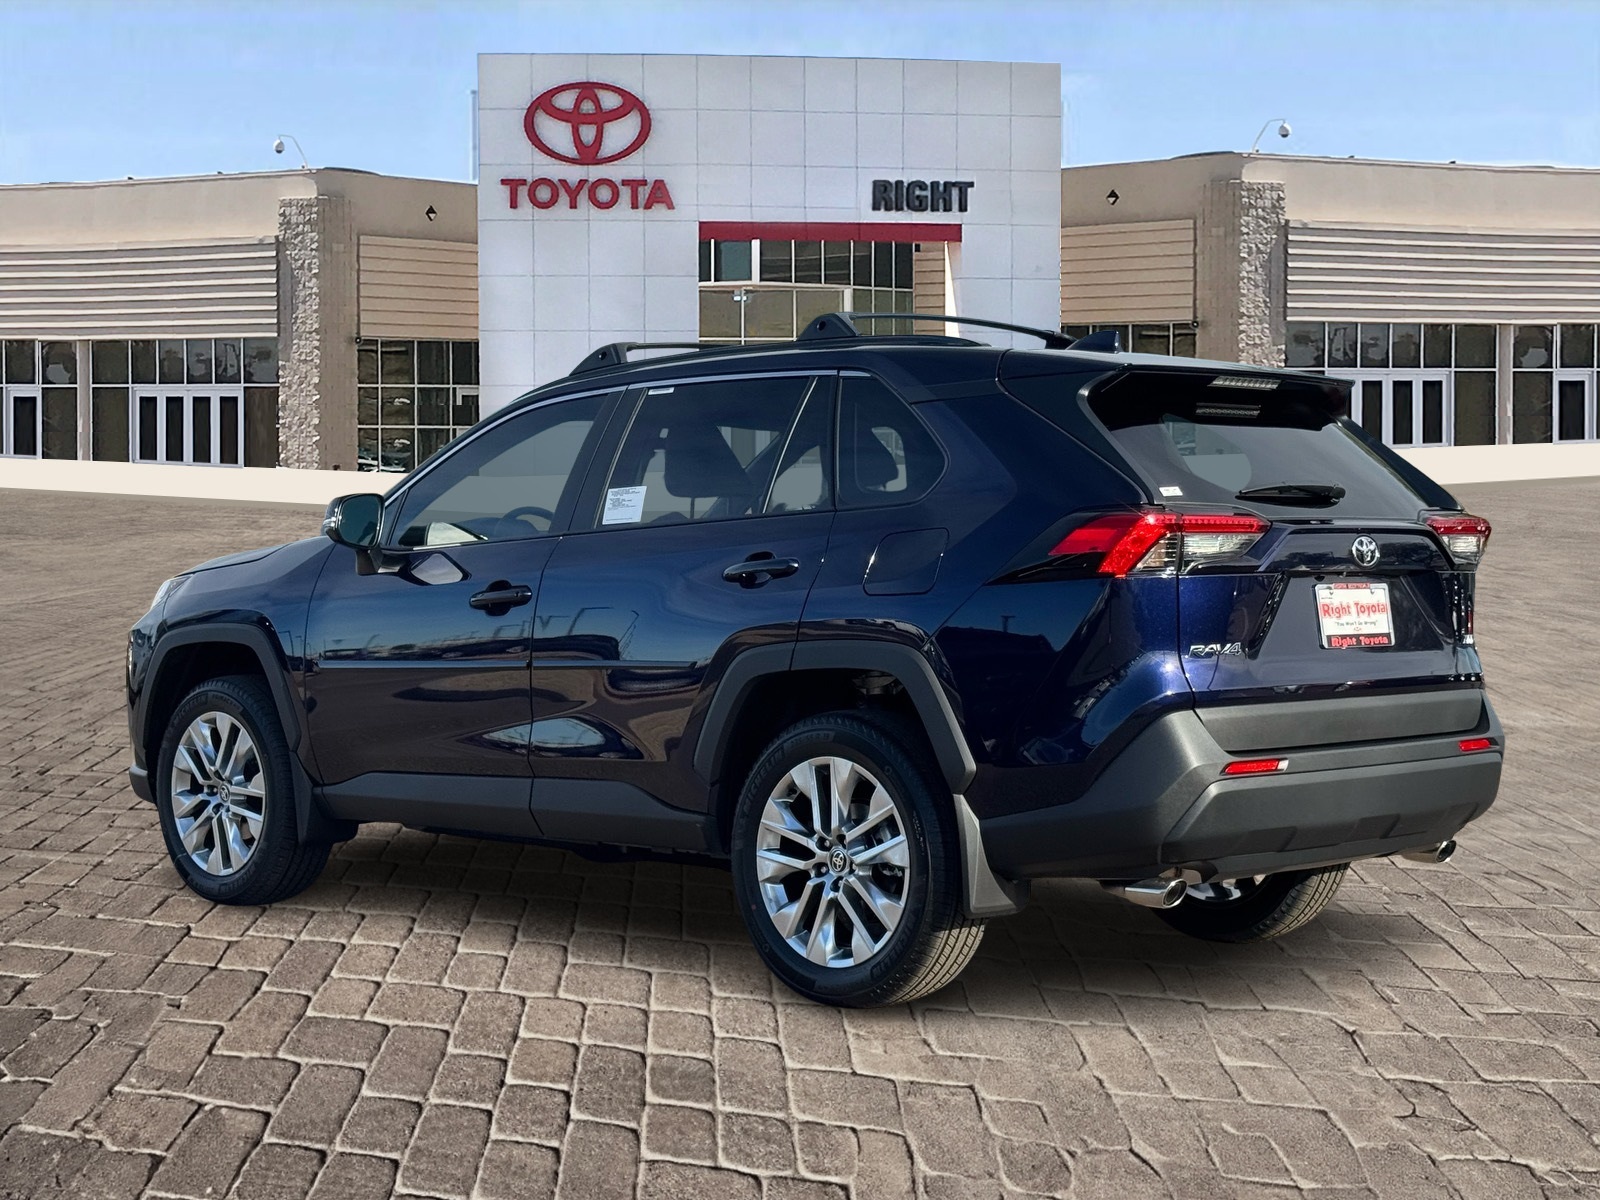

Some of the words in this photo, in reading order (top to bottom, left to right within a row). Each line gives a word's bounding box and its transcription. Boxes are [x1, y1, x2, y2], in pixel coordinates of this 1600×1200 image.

[501, 179, 675, 209] TOYOTA
[871, 180, 975, 212] RIGHT
[1321, 603, 1351, 618] Right
[1354, 602, 1387, 617] Toyota
[1189, 641, 1241, 656] RAV4
[1331, 635, 1357, 649] Right
[1359, 635, 1389, 646] Toyota
[743, 746, 785, 817] MICHELIN
